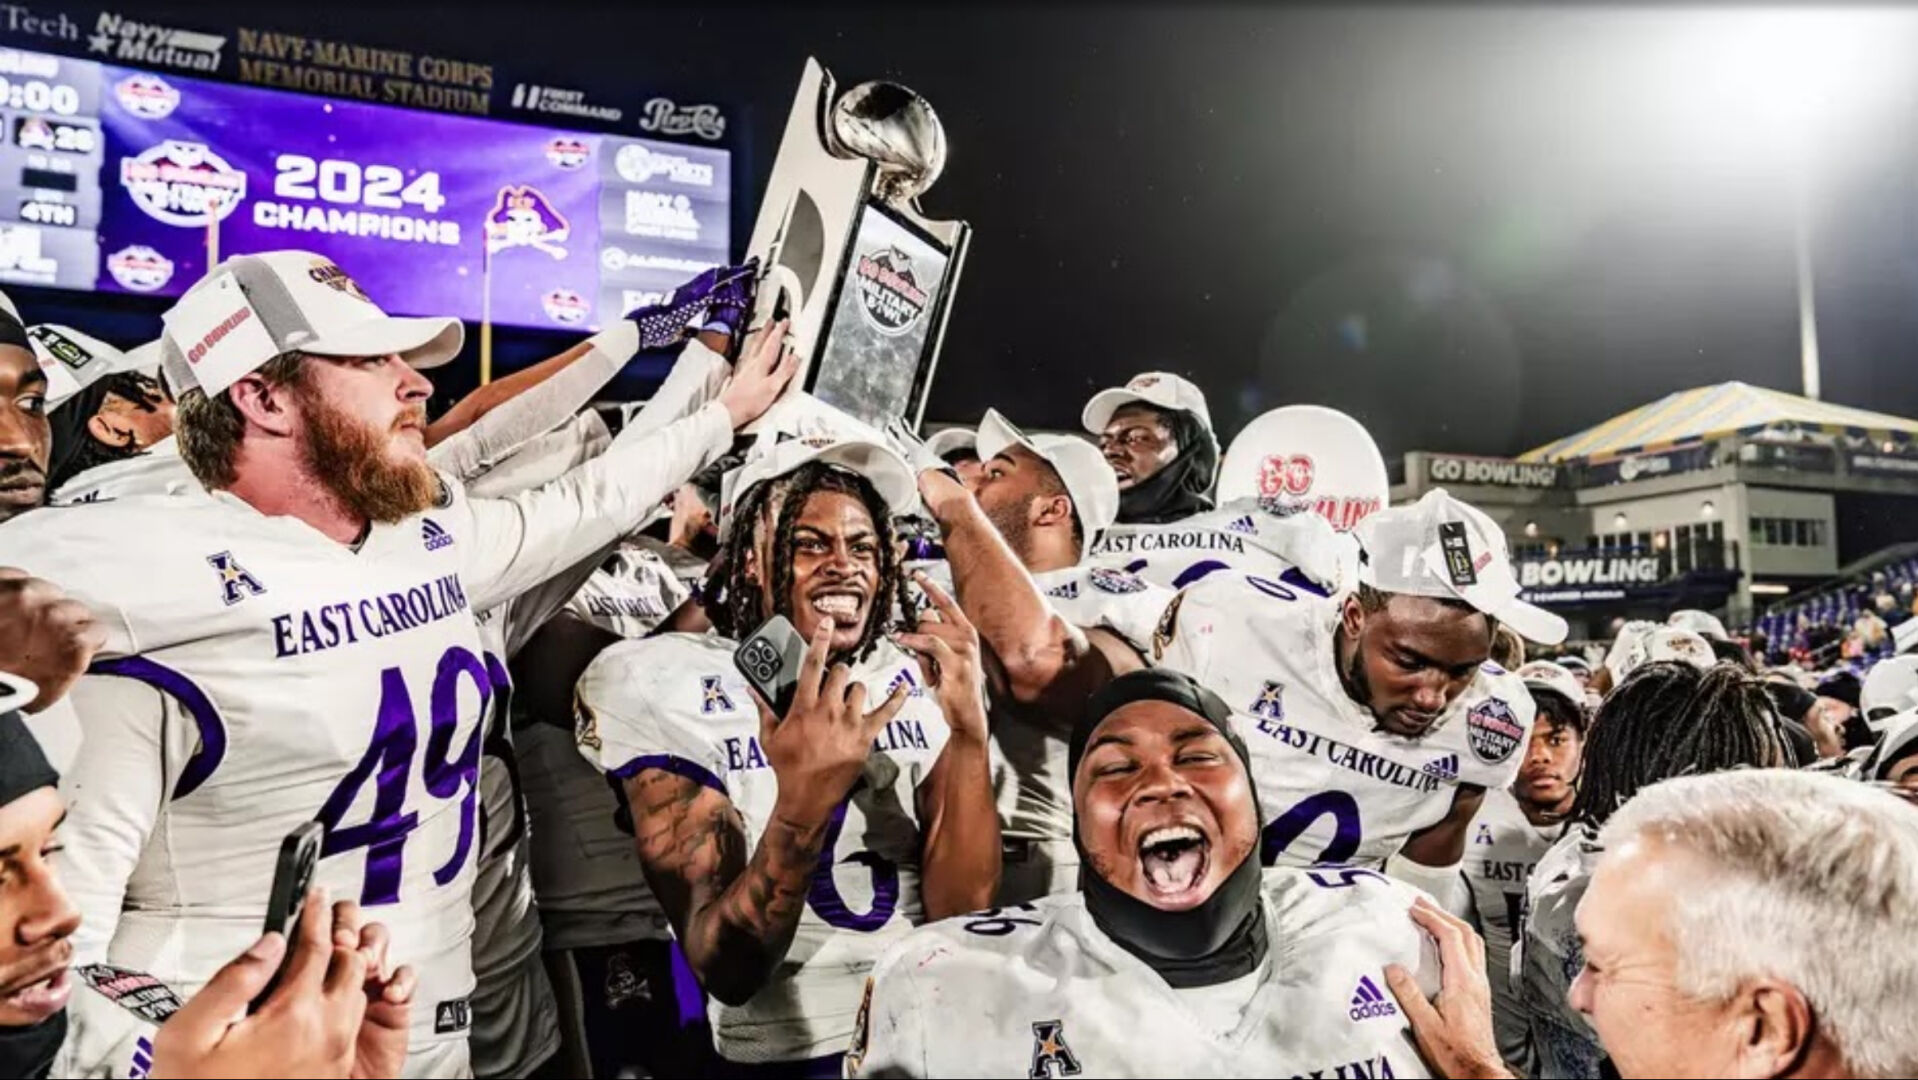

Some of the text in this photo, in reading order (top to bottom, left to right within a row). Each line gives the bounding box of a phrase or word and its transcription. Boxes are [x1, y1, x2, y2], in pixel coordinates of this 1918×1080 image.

[96, 12, 173, 46] Navy
[117, 38, 221, 71] Mutual
[238, 28, 493, 88] NAVY-MARINE CORPS
[239, 58, 490, 115] MEMORIAL STADIUM
[538, 100, 622, 121] COMMAND
[274, 154, 446, 213] 2024
[253, 201, 461, 245] CHAMPIONS
[188, 342, 207, 364] GO
[1258, 454, 1314, 498] GO
[1431, 459, 1557, 486] GO BOWLING!
[1141, 530, 1245, 553] CAROLINA
[1521, 558, 1659, 586] BOWLING!
[271, 573, 468, 658] EAST CAROLINA
[724, 720, 929, 771] EA LINA
[319, 646, 492, 906] 49
[1484, 860, 1523, 882] EAST
